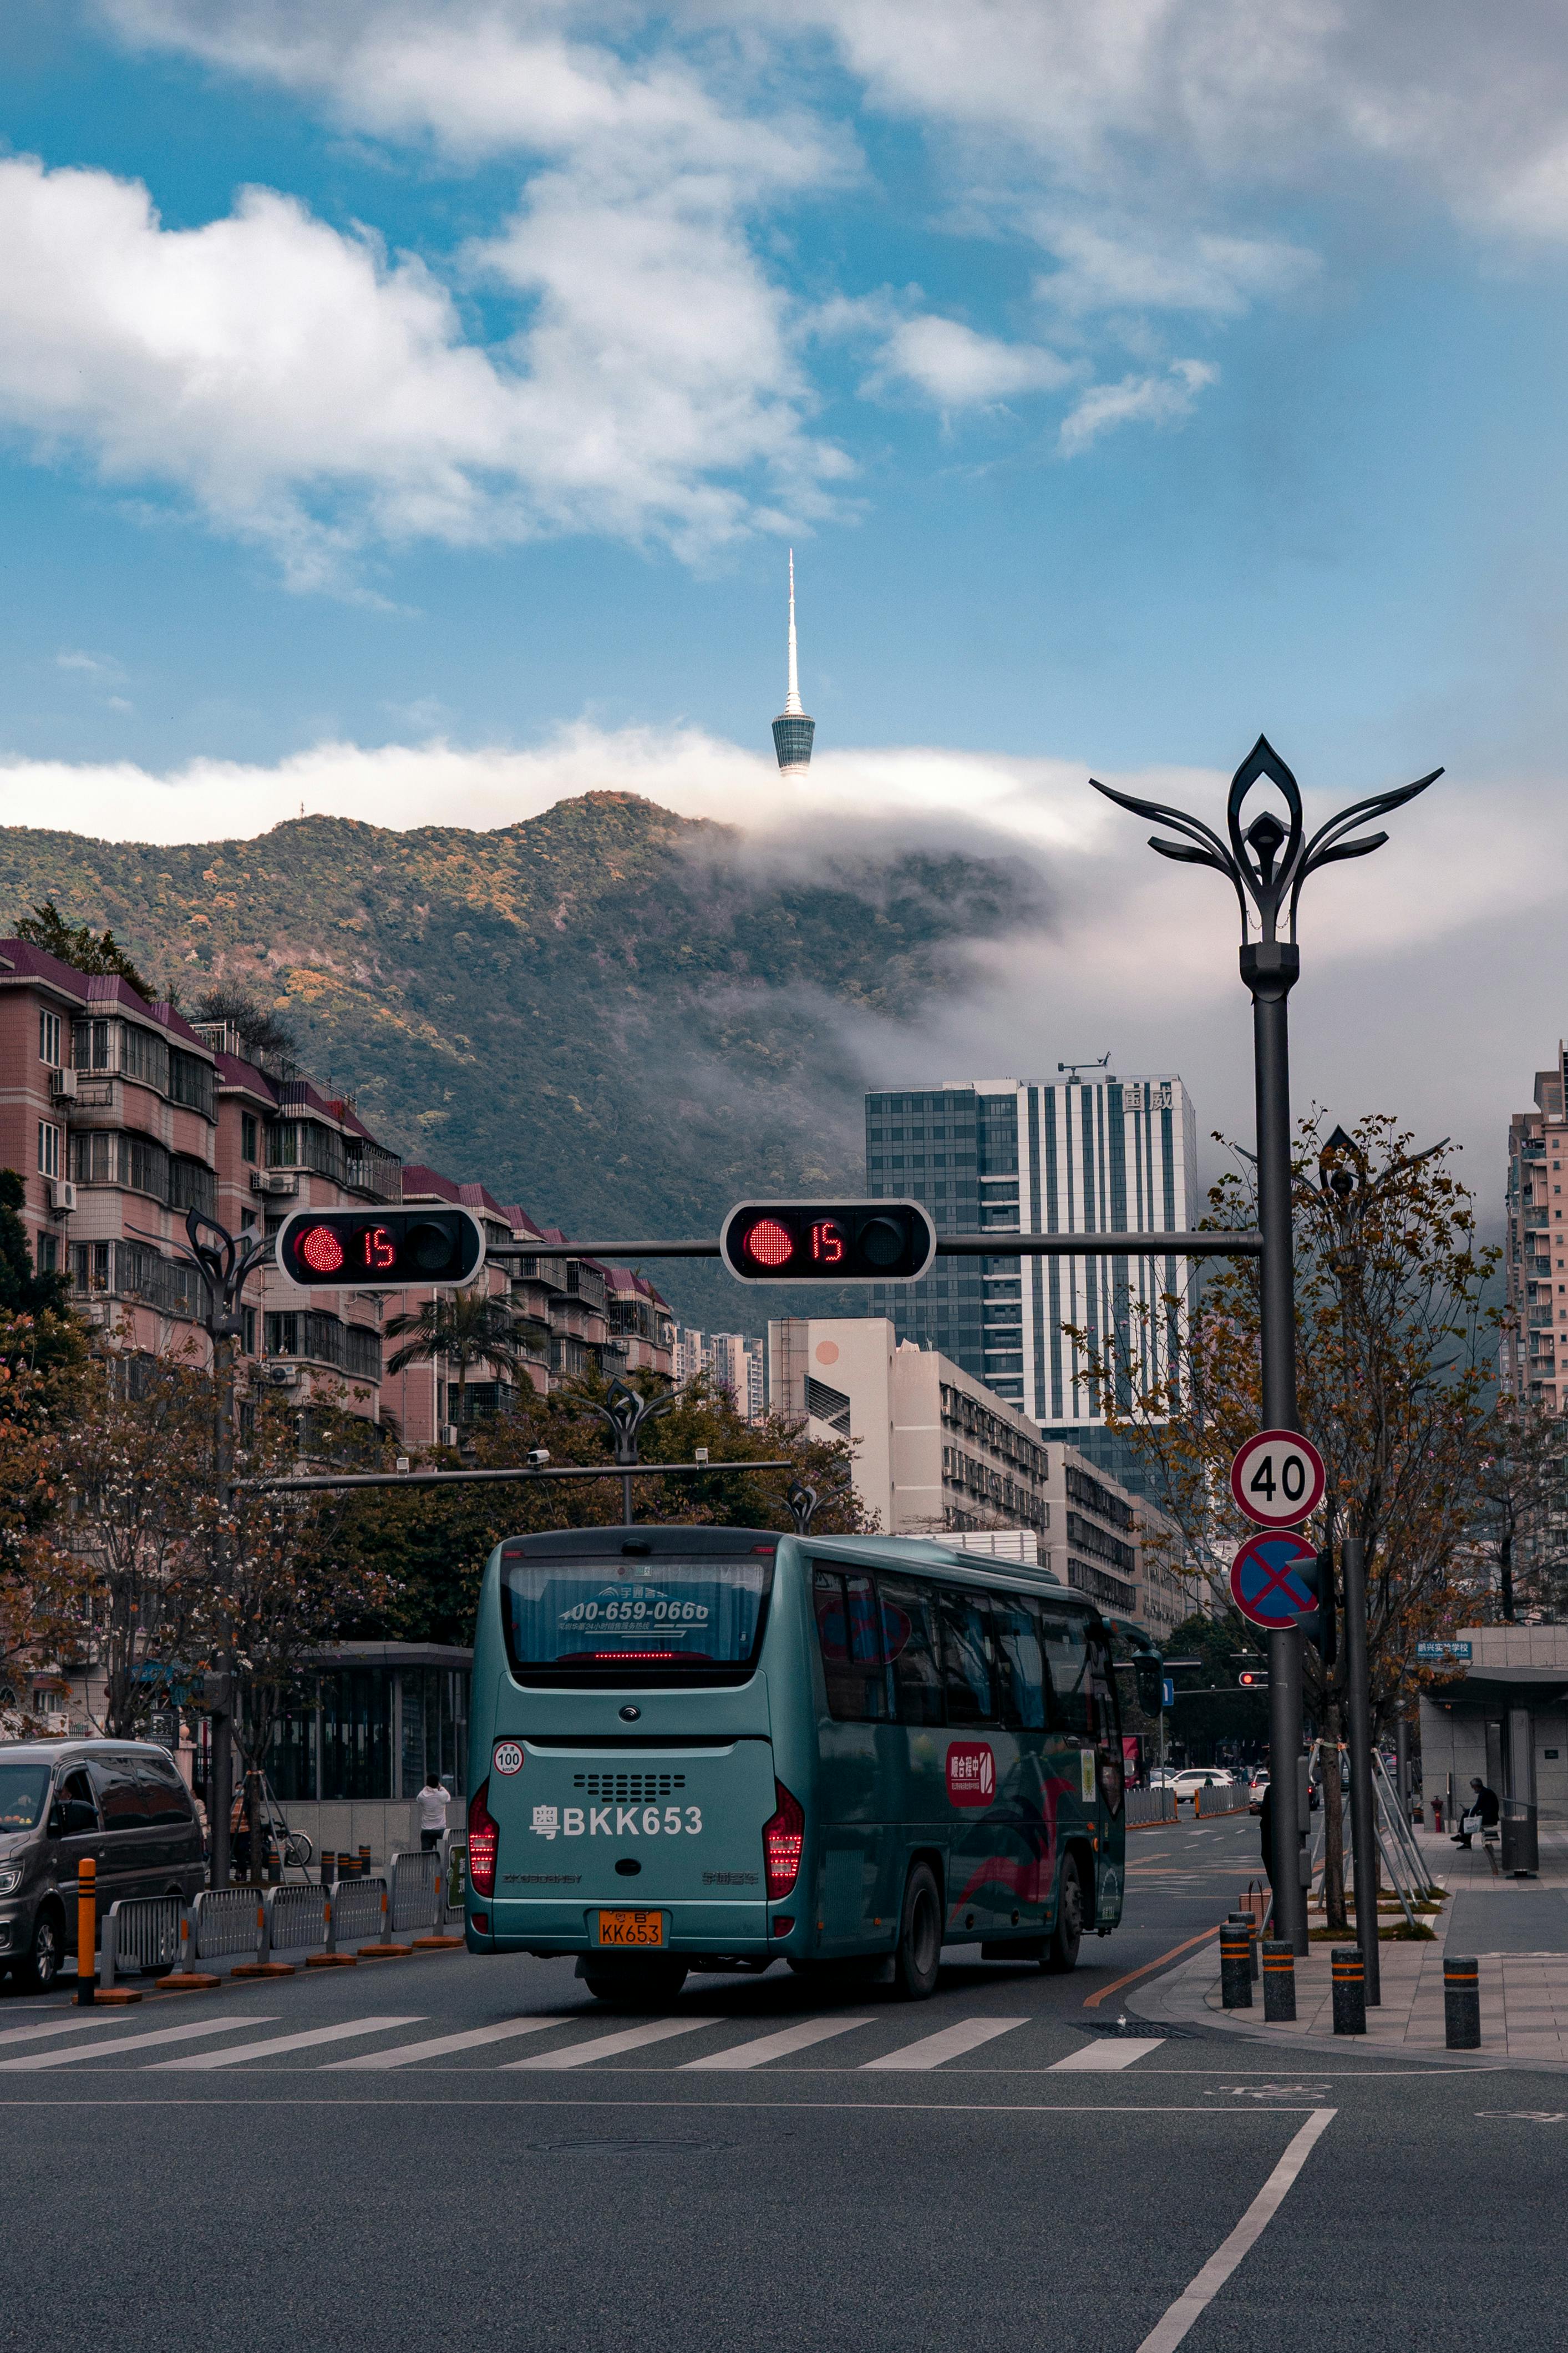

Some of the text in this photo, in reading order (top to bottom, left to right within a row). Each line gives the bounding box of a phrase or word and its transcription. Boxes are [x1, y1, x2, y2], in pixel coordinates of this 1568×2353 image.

[1122, 1086, 1174, 1113] 国威
[366, 1229, 393, 1266] 15
[814, 1223, 841, 1261] 15
[1251, 1455, 1306, 1502] 40
[498, 1753, 519, 1765] 100
[529, 1805, 703, 1840] 粤BKK653
[701, 1871, 759, 1885] 宇通客车
[602, 1925, 659, 1943] KK653
